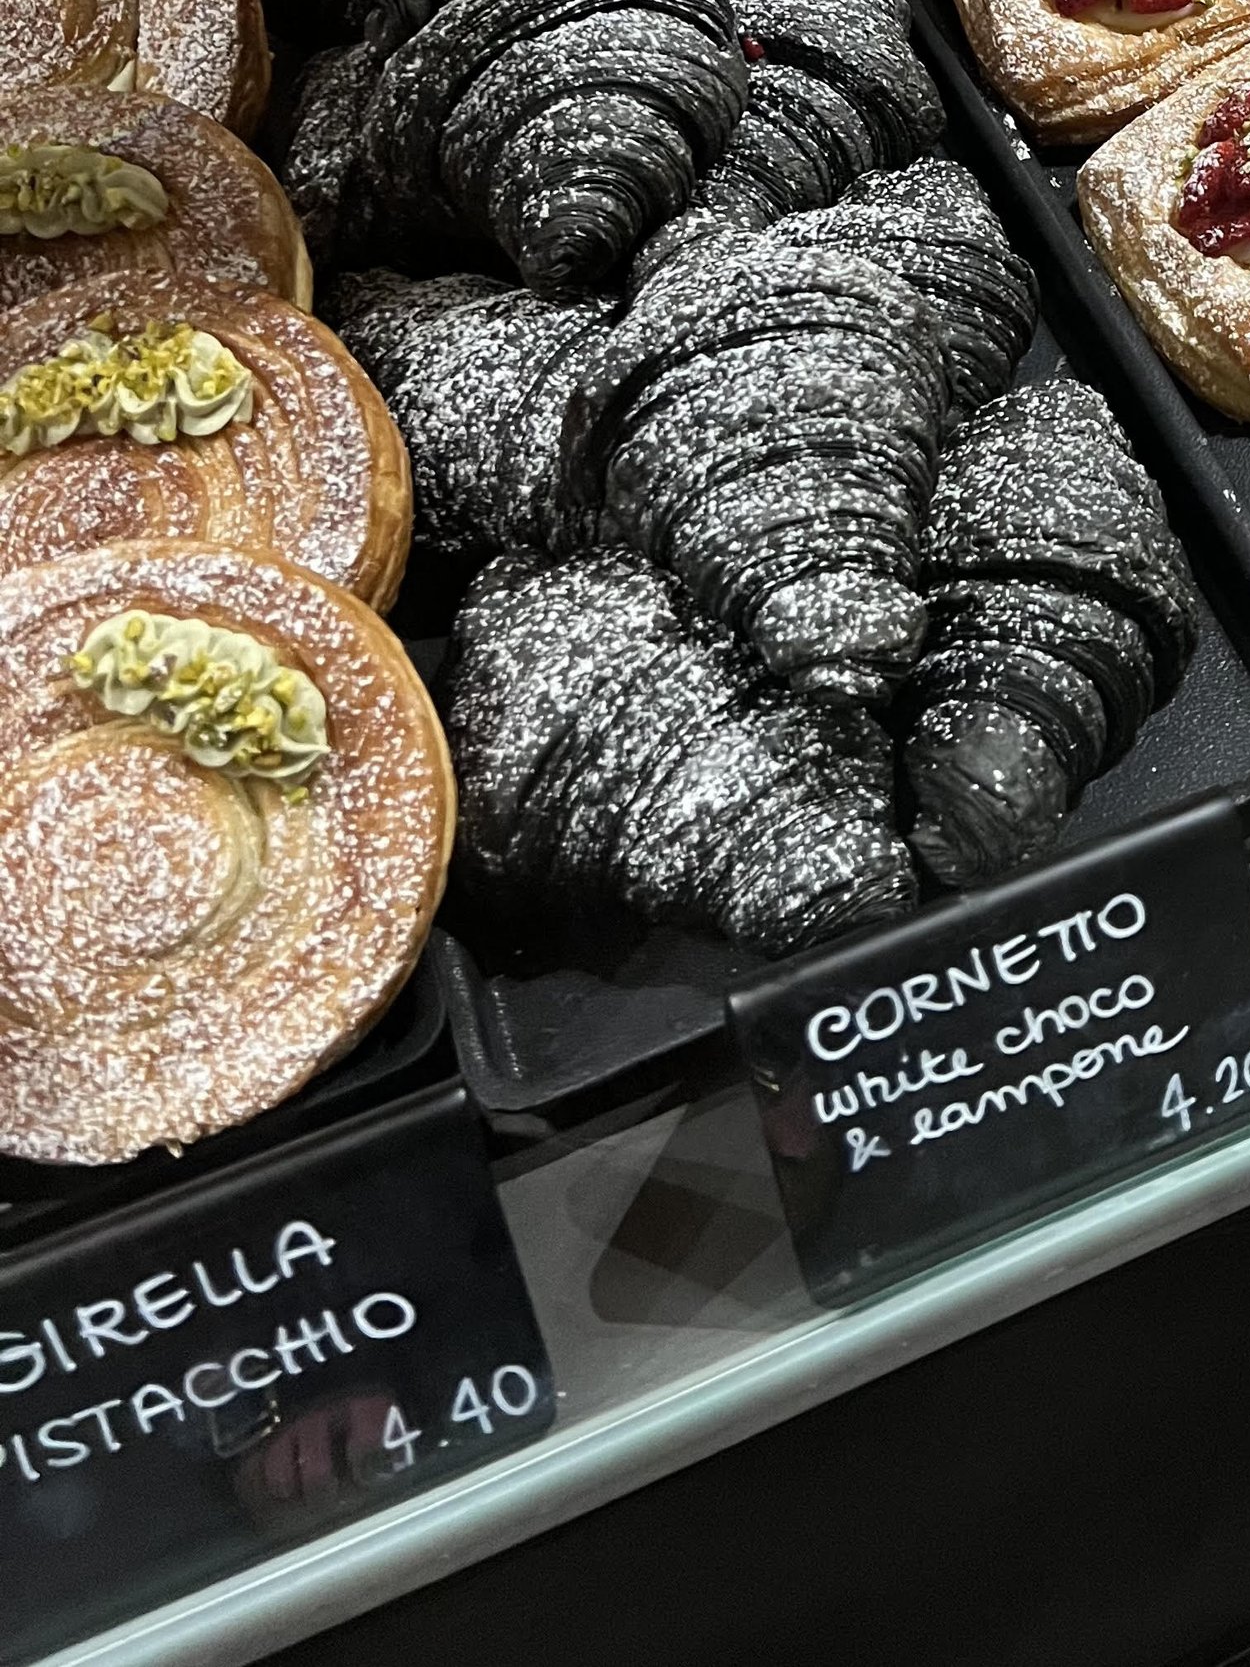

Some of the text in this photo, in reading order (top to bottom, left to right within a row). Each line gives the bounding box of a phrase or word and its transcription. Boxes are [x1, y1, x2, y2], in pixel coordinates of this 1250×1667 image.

[808, 894, 1146, 1061] CORNETTO
[814, 975, 1154, 1123] white choco
[847, 1128, 891, 1172] &
[0, 1221, 336, 1393] GIRELLA
[0, 1292, 416, 1481] ISTACCHIO
[383, 1365, 536, 1470] 4.40
